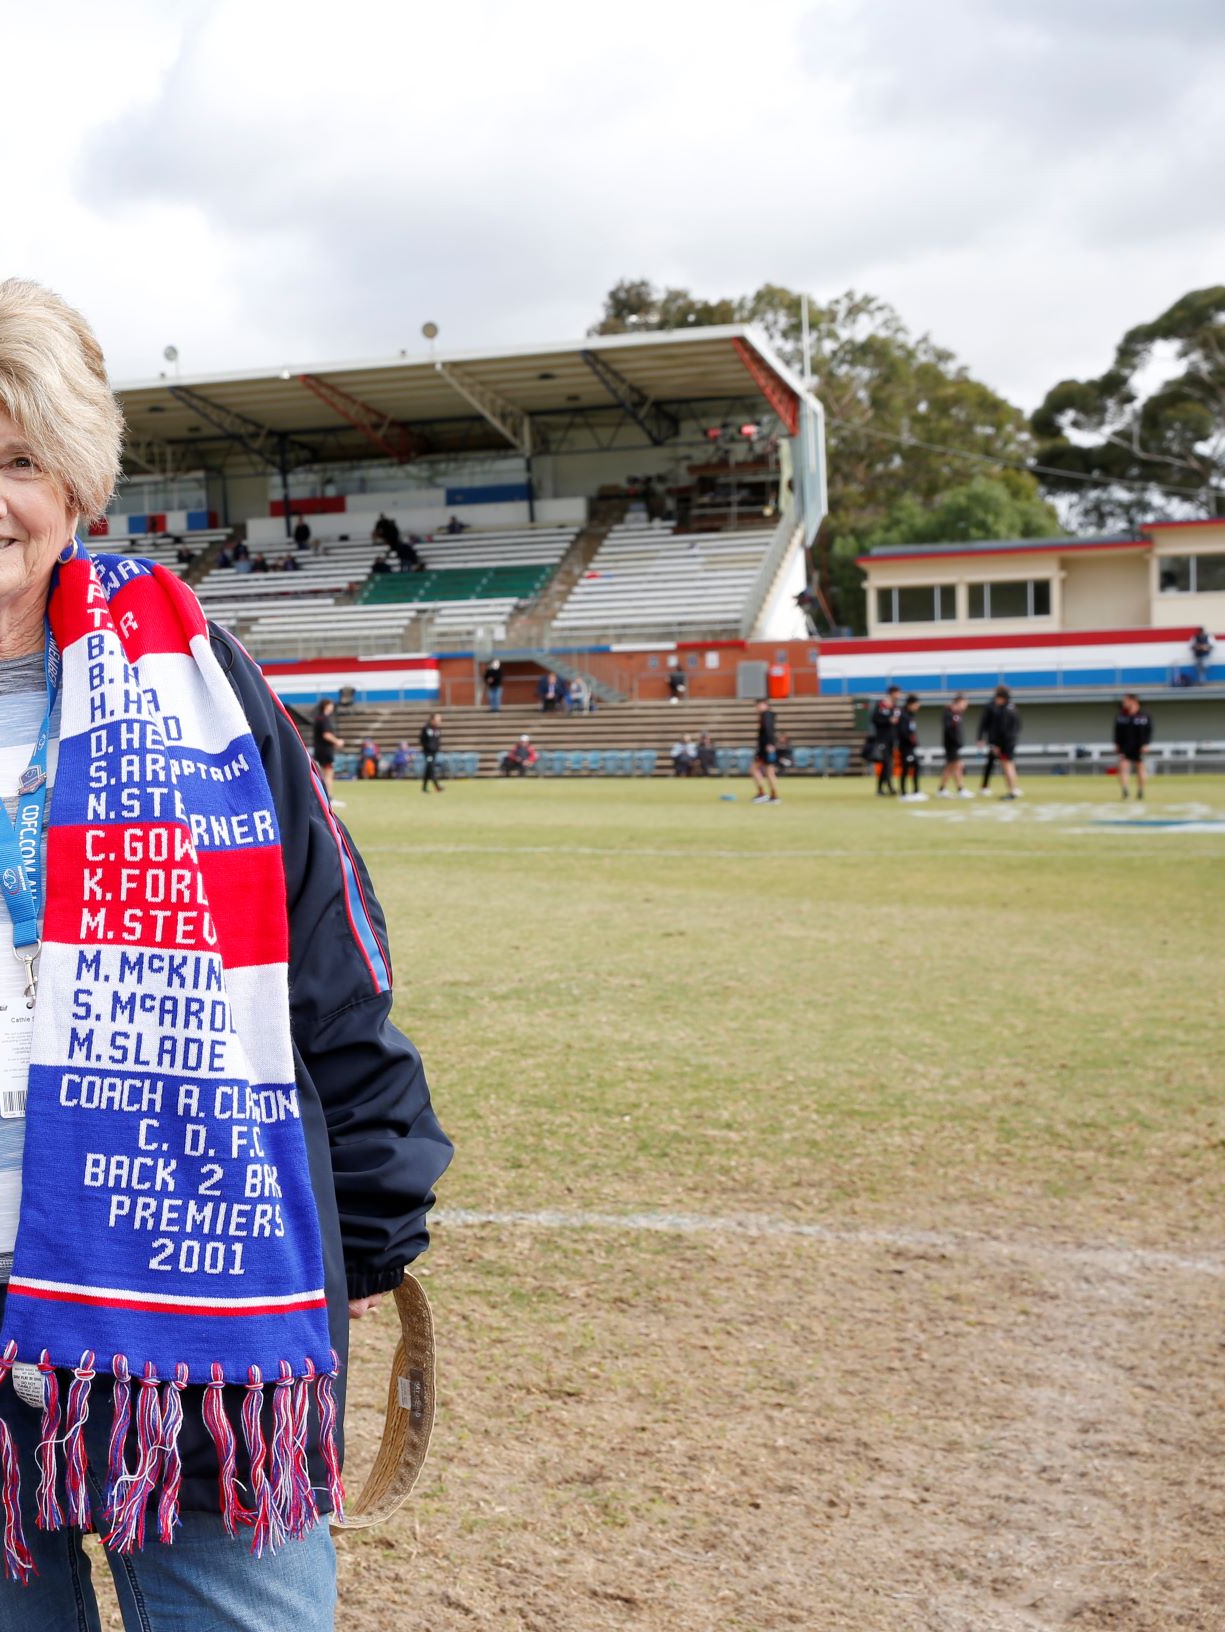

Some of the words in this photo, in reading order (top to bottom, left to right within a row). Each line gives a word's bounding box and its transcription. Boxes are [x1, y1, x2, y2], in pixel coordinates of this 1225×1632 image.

[68, 1027, 227, 1072] M.SLADE
[59, 1073, 165, 1113] COACH
[83, 1152, 177, 1193] BACK
[198, 1163, 224, 1197] 2
[108, 1194, 285, 1238] PREMIERS
[148, 1237, 246, 1276] 2001
